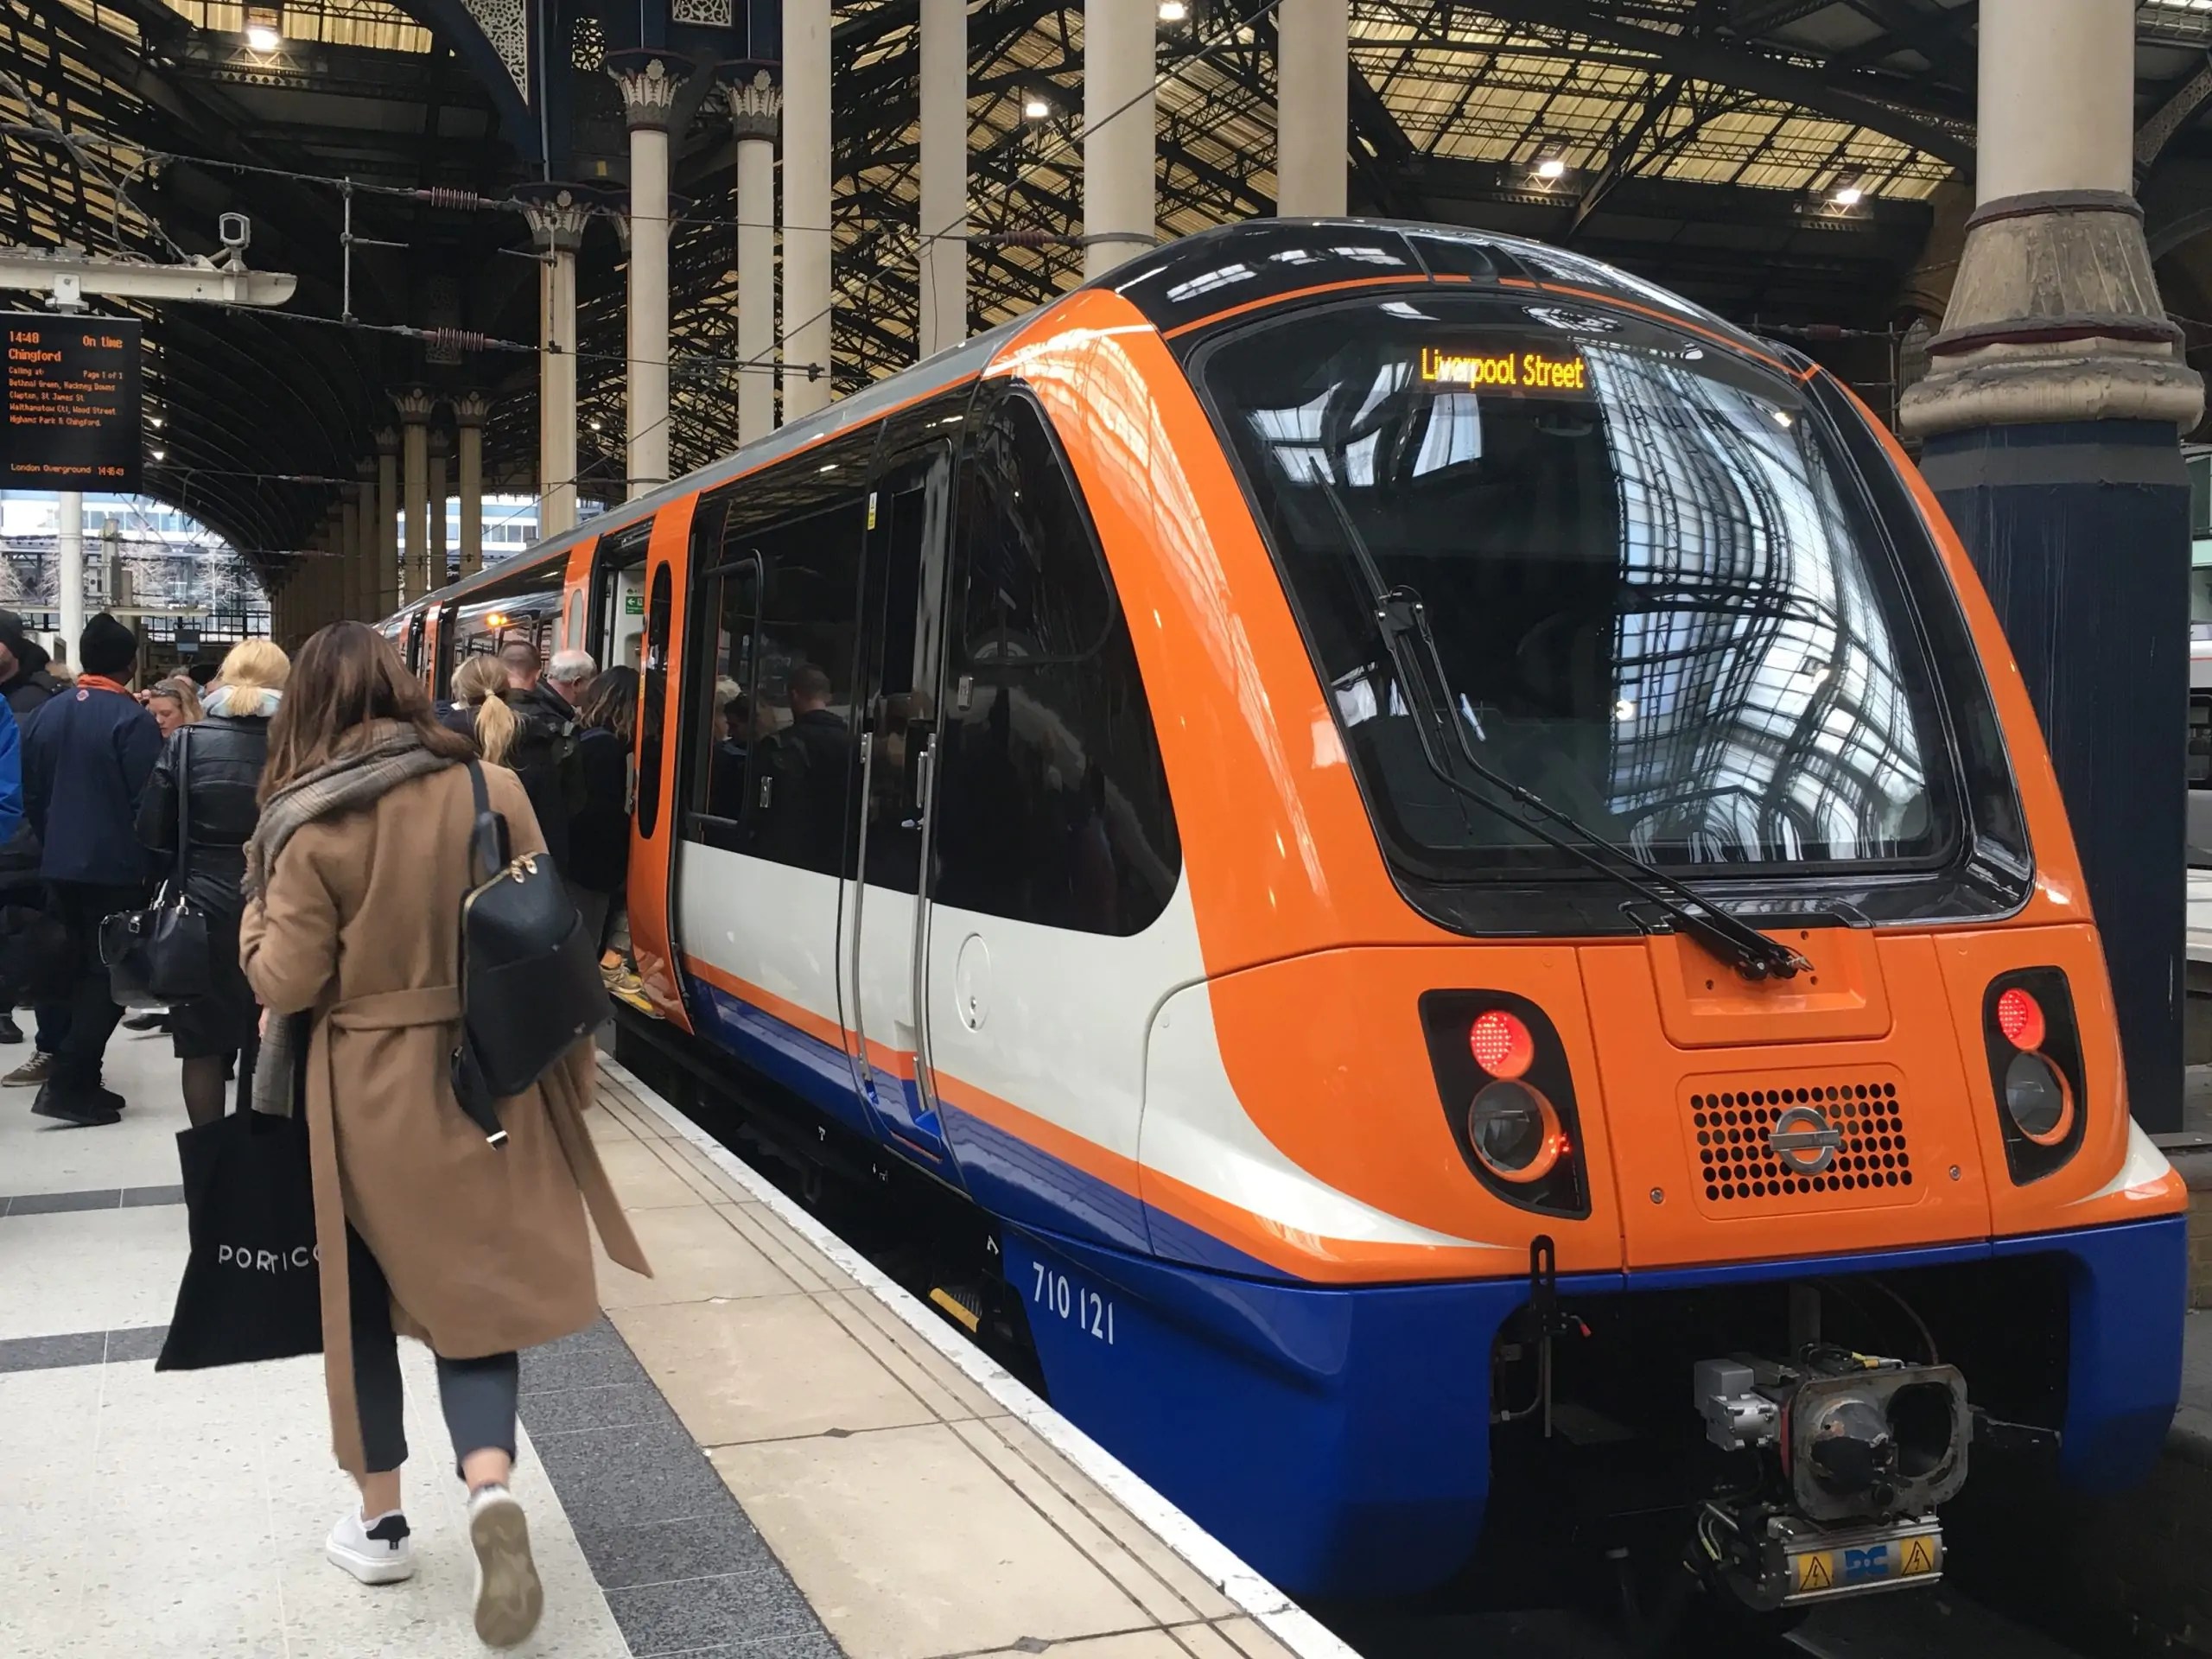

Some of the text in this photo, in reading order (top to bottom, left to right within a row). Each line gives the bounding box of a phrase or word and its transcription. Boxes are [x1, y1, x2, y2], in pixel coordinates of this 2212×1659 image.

[82, 335, 97, 347] On
[101, 336, 124, 349] time
[8, 347, 61, 363] Chingford
[9, 366, 32, 377] Calling
[83, 370, 99, 380] Page
[1421, 347, 1584, 389] Liverpool Street
[9, 378, 36, 387] Bethnal
[64, 381, 92, 391] Hackney
[52, 393, 73, 402] James
[10, 403, 55, 412] Walthamstow
[73, 406, 91, 415] Wood
[92, 407, 116, 416] Street
[39, 416, 56, 424] Park
[10, 463, 41, 472] London
[43, 464, 92, 474] Overground
[1033, 1261, 1114, 1344] 710 121
